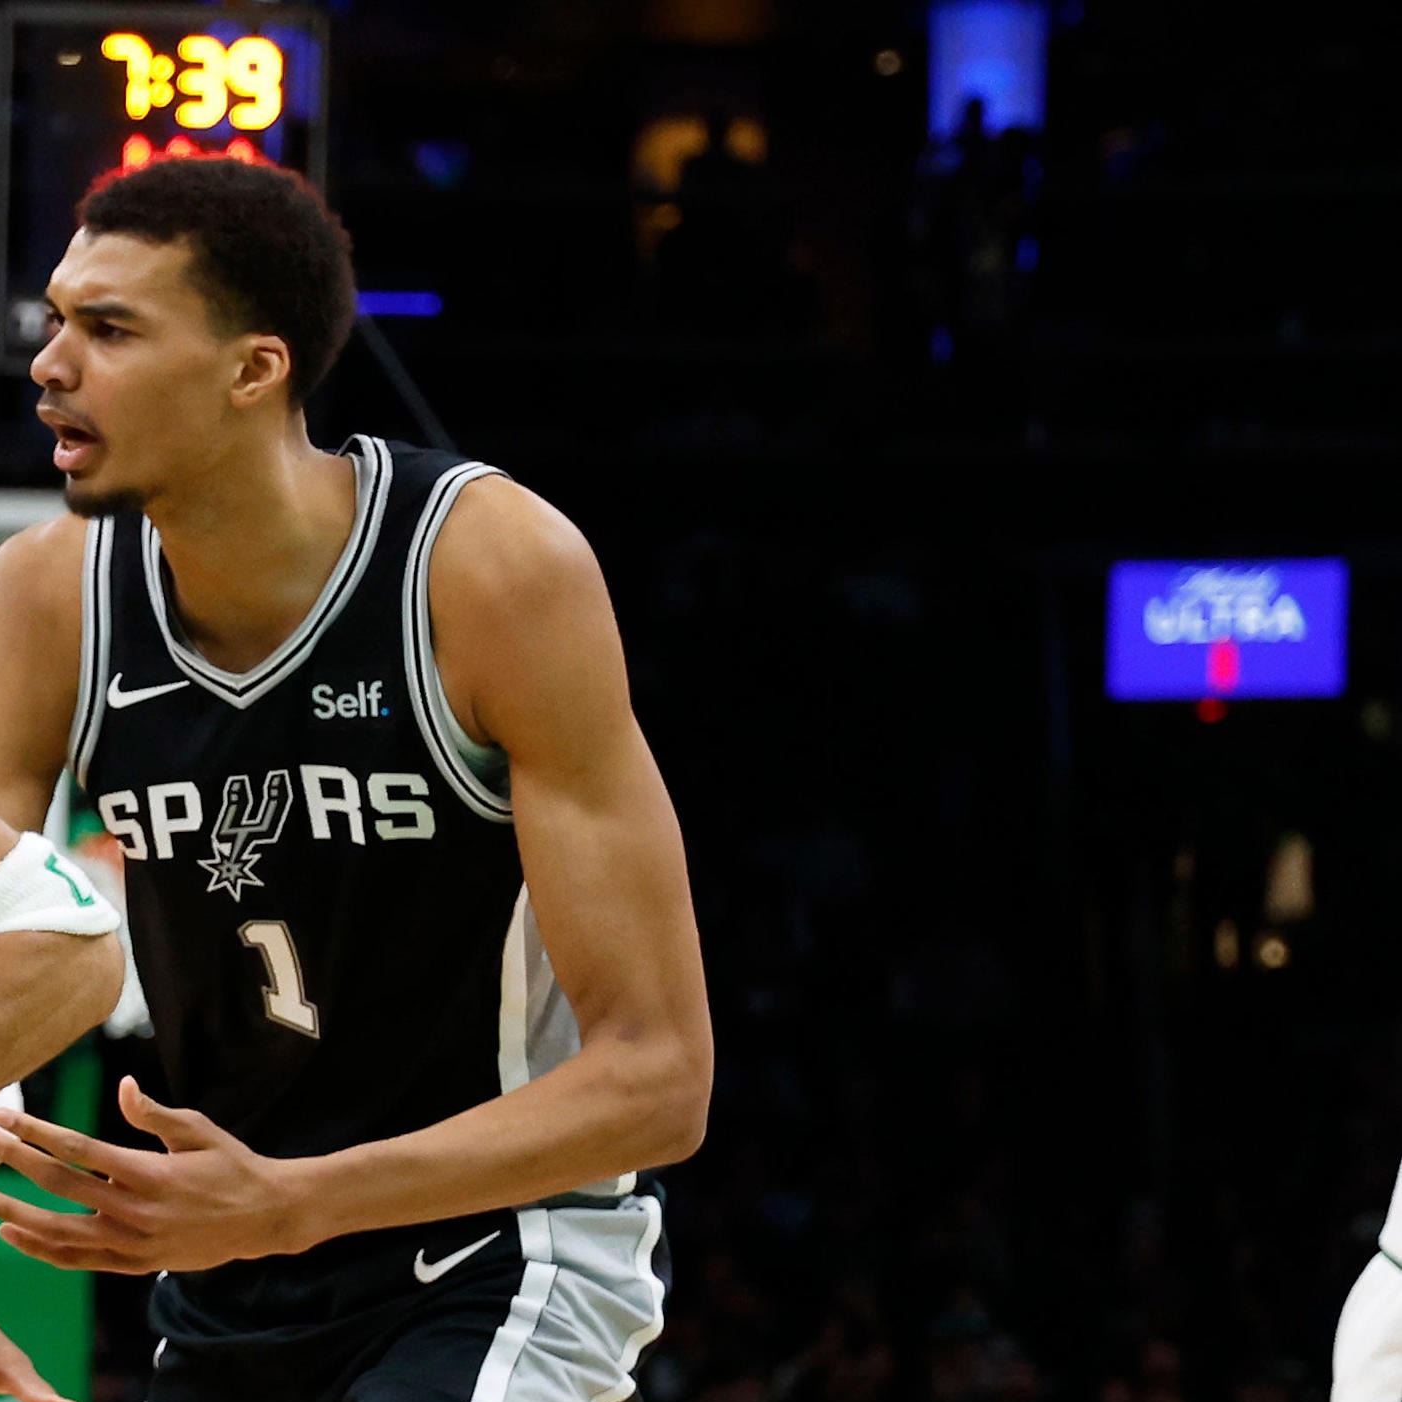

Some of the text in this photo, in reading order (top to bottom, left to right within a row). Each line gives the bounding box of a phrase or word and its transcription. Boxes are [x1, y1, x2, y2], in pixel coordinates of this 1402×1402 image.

[101, 32, 283, 130] 7:39
[311, 680, 390, 720] Self.
[237, 920, 320, 1040] 1
